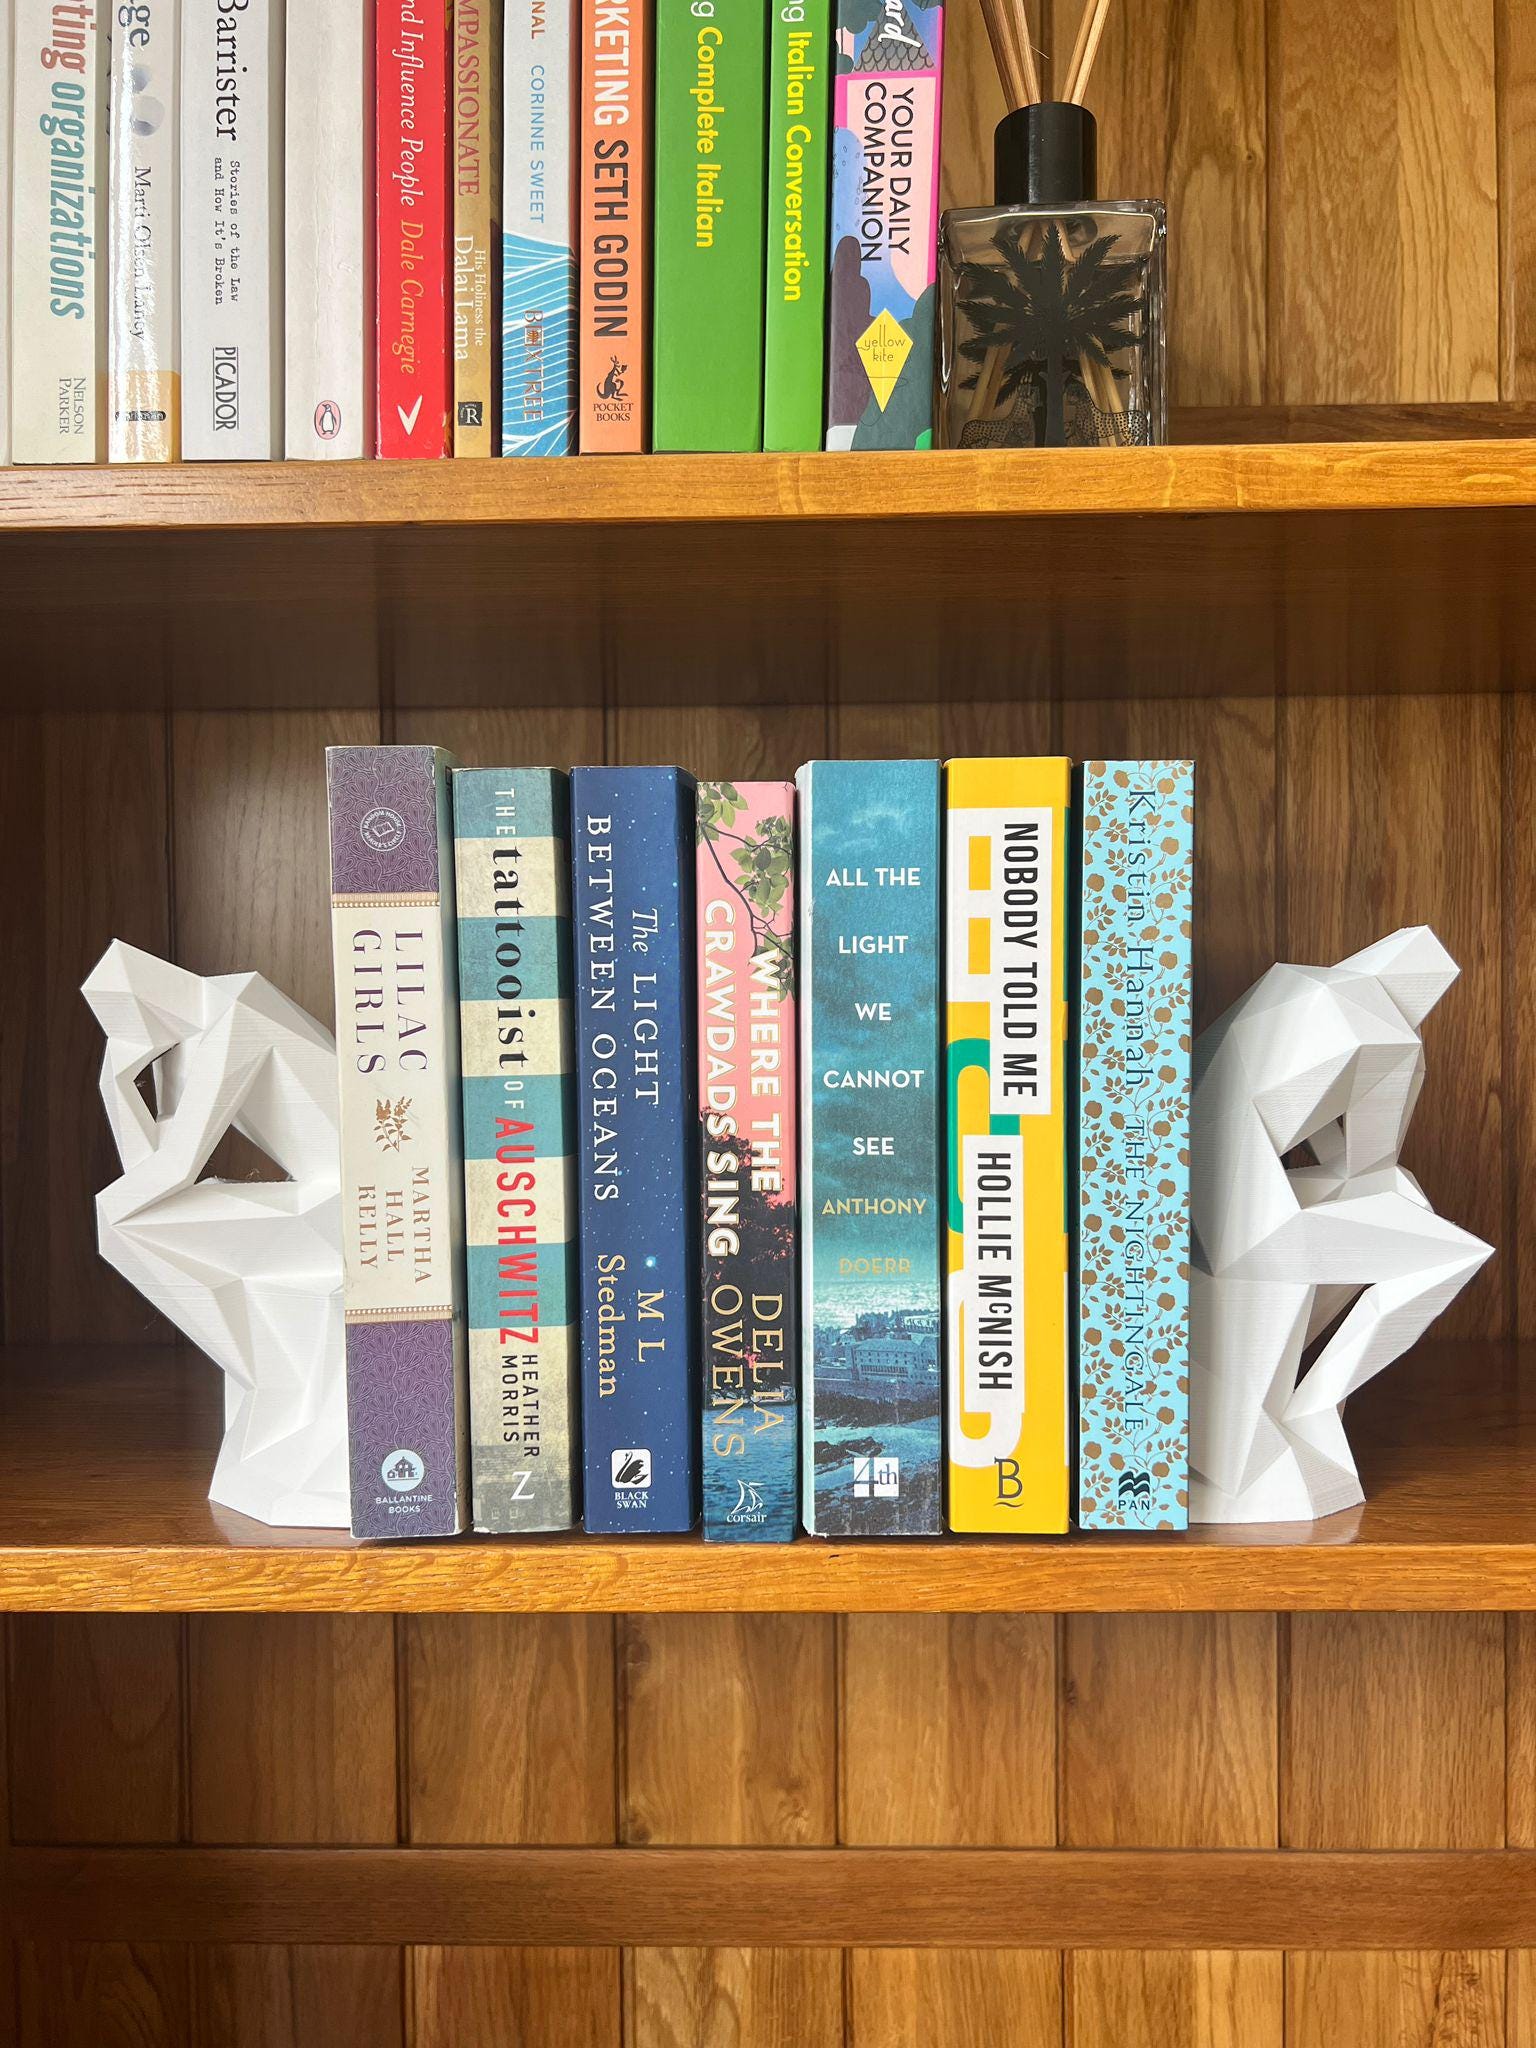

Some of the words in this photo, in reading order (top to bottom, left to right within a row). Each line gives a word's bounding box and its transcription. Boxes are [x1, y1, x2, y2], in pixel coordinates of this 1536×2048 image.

[41, 0, 97, 74] ting
[118, 0, 151, 47] ge
[392, 31, 424, 129] Influence
[689, 26, 725, 154] Complete
[787, 32, 815, 115] Italian
[531, 65, 545, 151] CORINNE
[890, 87, 914, 168] YOUR
[134, 167, 151, 218] Marti
[214, 157, 225, 179] and
[230, 161, 241, 214] Stories
[392, 139, 424, 206] People
[530, 160, 545, 223] SWEET
[594, 139, 629, 222] SETH
[861, 82, 887, 262] COMPANION
[39, 81, 96, 319] organizations
[215, 189, 225, 213] How
[697, 163, 724, 248] Italian
[784, 125, 812, 301] Conversation
[888, 177, 913, 255] DAILY
[215, 222, 226, 250] It's
[230, 223, 240, 239] of
[230, 250, 240, 269] the
[401, 221, 424, 270] Dale
[475, 250, 486, 270] His
[215, 258, 226, 305] Broken
[230, 278, 241, 302] Law
[454, 235, 474, 294] Dalai
[594, 234, 629, 337] GODIN
[391, 280, 424, 375] Carnegie
[475, 273, 486, 325] Holiness
[454, 299, 474, 360] Lama
[475, 329, 486, 346] the
[864, 324, 907, 349] yellow
[873, 348, 895, 363] kite
[59, 378, 70, 434] PARKER
[74, 378, 87, 434] NELSON
[214, 347, 238, 431] PICADOR
[593, 403, 634, 412] POCKET
[596, 412, 631, 422] BOOKS
[494, 788, 516, 835] THE
[826, 867, 868, 887] ALL
[875, 867, 920, 887] THE
[1003, 823, 1039, 949] NOBODY
[1128, 790, 1156, 923] Kristin
[587, 815, 616, 1012] BETWEEN
[632, 908, 659, 954] The
[492, 846, 536, 1069] tattooist
[838, 935, 908, 955] LIGHT
[352, 929, 387, 1074] GIRLS
[395, 930, 428, 1071] LILAC
[705, 898, 739, 1136] CRAWDADS
[750, 948, 781, 1097] WHERE
[854, 1002, 892, 1021] WE
[1003, 962, 1038, 1039] TOLD
[1125, 946, 1155, 1087] Hannah
[633, 973, 659, 1105] LIGHT
[504, 1081, 524, 1109] OF
[823, 1070, 925, 1089] CANNOT
[1003, 1054, 1037, 1097] ME
[591, 1033, 619, 1200] OCEANS
[852, 1137, 895, 1156] SEE
[751, 1113, 782, 1192] THE
[1125, 1119, 1145, 1179] THE
[358, 1185, 378, 1269] KELLY
[385, 1190, 405, 1262] HALL
[412, 1166, 432, 1284] MARTHA
[495, 1117, 539, 1344] AUSCHWITZ
[706, 1151, 740, 1257] SING
[822, 1198, 927, 1216] ANTHONY
[977, 1153, 1012, 1261] HOLLIE
[839, 1258, 911, 1275] DOERR
[597, 1254, 626, 1398] Stedman
[638, 1289, 665, 1322] M
[1124, 1201, 1145, 1431] NIGHTINGALE
[638, 1339, 665, 1363] L
[711, 1284, 745, 1457] OWENS
[752, 1293, 784, 1434] DELIA
[502, 1355, 520, 1442] MORRIS
[522, 1354, 540, 1457] HEATHER
[375, 1494, 433, 1505] BALLANTINE
[510, 1471, 536, 1500] Z
[614, 1491, 649, 1500] BLACK
[853, 1450, 899, 1497] 4th
[994, 1456, 1023, 1499] B
[388, 1504, 421, 1514] BOOKS
[616, 1500, 647, 1509] SWAN
[726, 1512, 767, 1523] corsair
[1118, 1499, 1150, 1510] PAN
